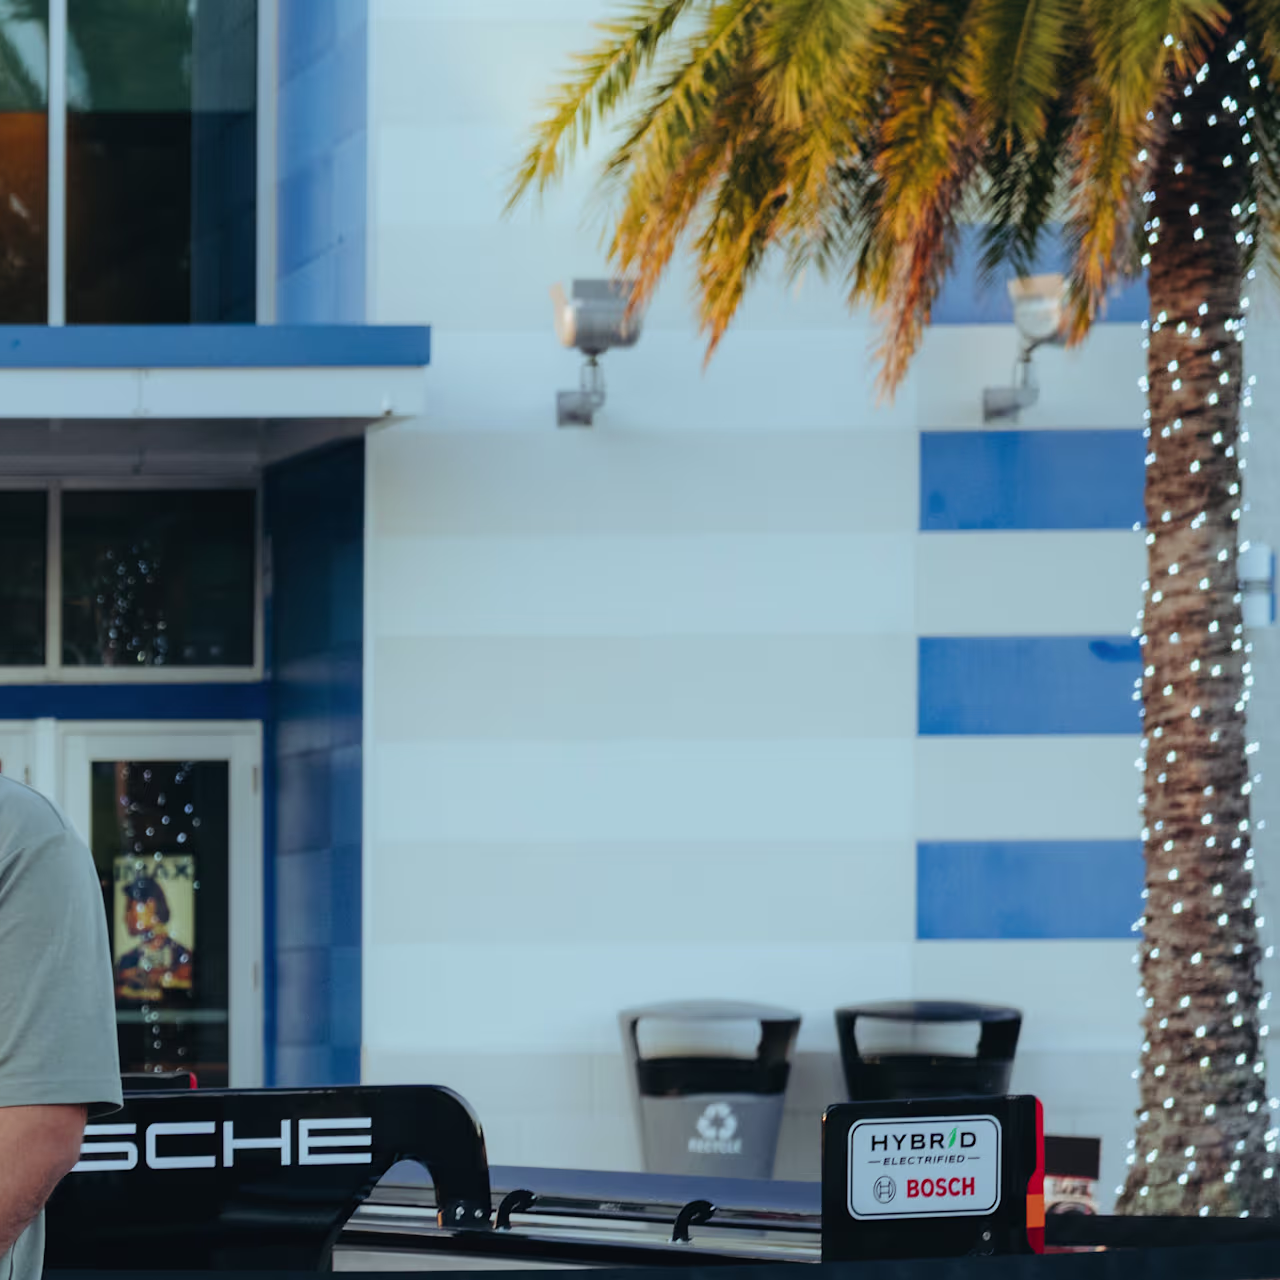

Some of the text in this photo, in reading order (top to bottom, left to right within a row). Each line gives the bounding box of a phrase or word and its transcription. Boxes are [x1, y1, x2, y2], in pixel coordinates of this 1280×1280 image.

[871, 1128, 977, 1152] HYBRID
[883, 1154, 965, 1166] ELECTRIFIED
[906, 1177, 976, 1199] BOSCH
